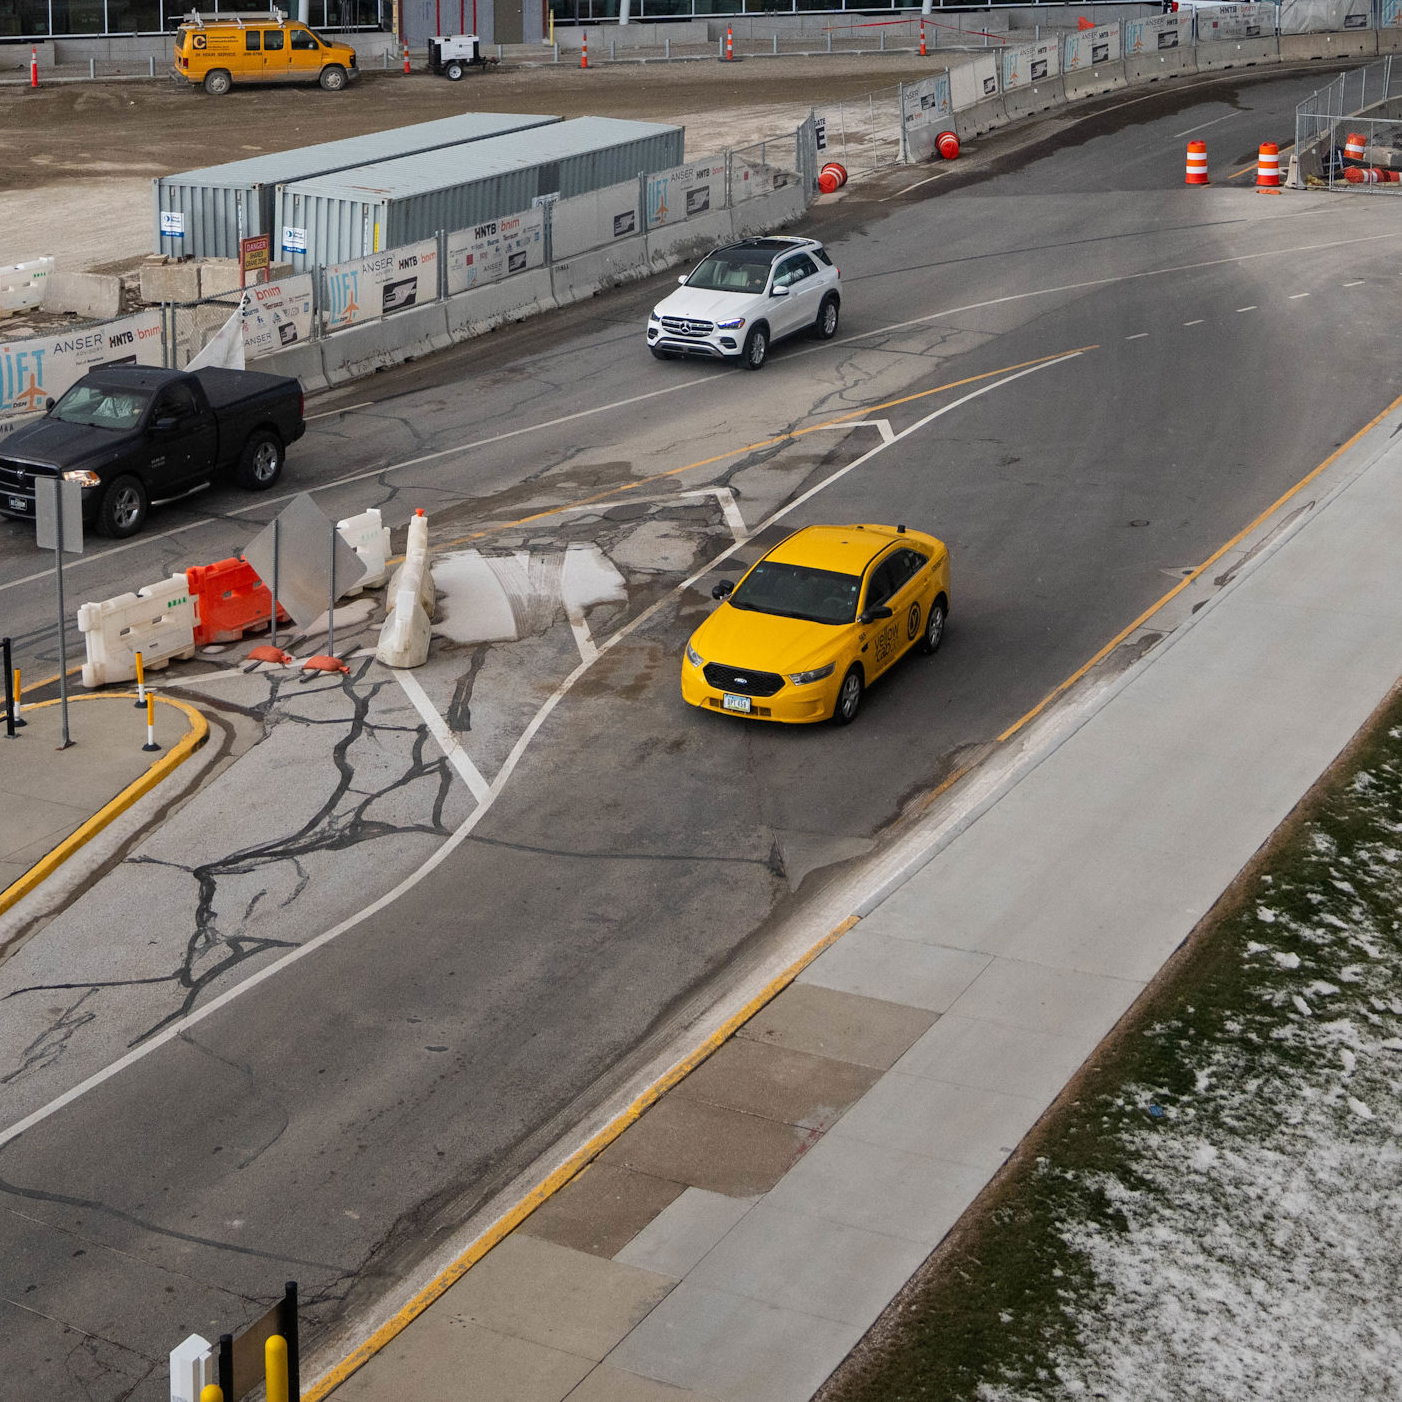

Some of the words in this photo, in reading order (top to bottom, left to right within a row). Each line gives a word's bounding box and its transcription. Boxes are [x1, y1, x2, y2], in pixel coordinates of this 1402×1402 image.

[815, 126, 826, 150] E
[670, 168, 694, 182] ANSER
[474, 223, 497, 240] HNTB
[500, 218, 519, 231] bnim
[246, 240, 267, 252] DANGER
[362, 257, 393, 276] ANSER
[398, 255, 418, 271] HNTB
[254, 286, 281, 301] bnim
[53, 333, 103, 355] ANSER
[109, 331, 134, 349] HNTB
[136, 325, 161, 340] bnim
[244, 332, 272, 347] ANSER
